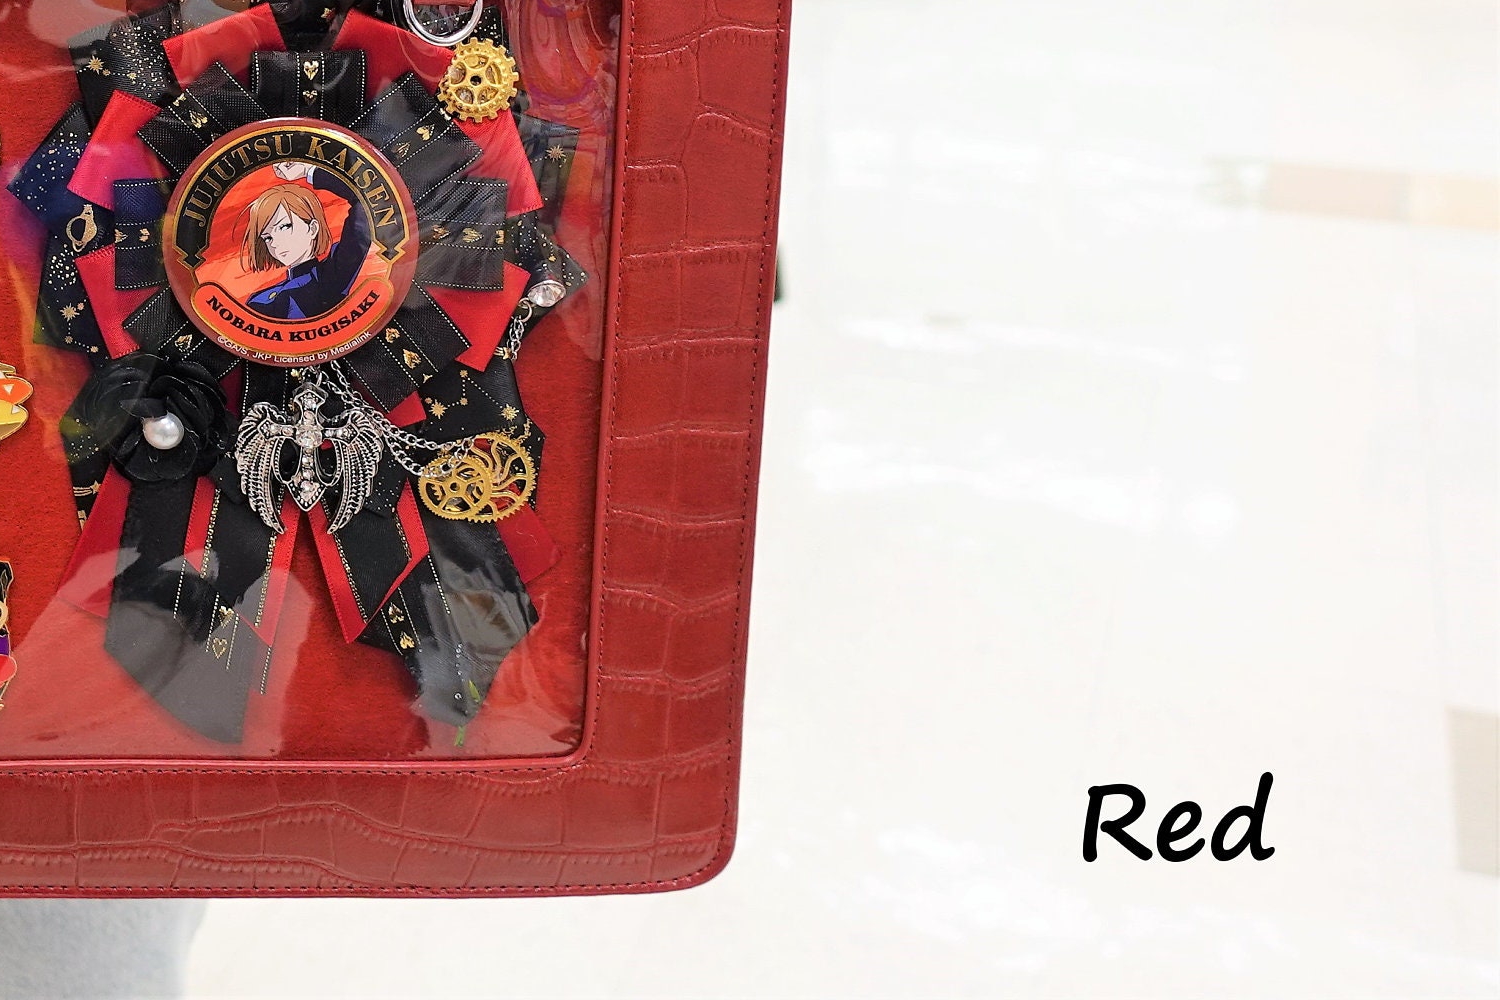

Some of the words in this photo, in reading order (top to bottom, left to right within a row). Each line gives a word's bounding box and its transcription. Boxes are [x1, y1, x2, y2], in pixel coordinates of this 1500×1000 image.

[183, 134, 294, 227] JUJUTSU
[305, 136, 398, 228] KAISEN
[206, 296, 283, 342] NOBARA
[289, 290, 380, 342] KUGISAKI
[274, 354, 315, 363] Licensed
[317, 351, 329, 360] by
[331, 331, 372, 356] Medialink
